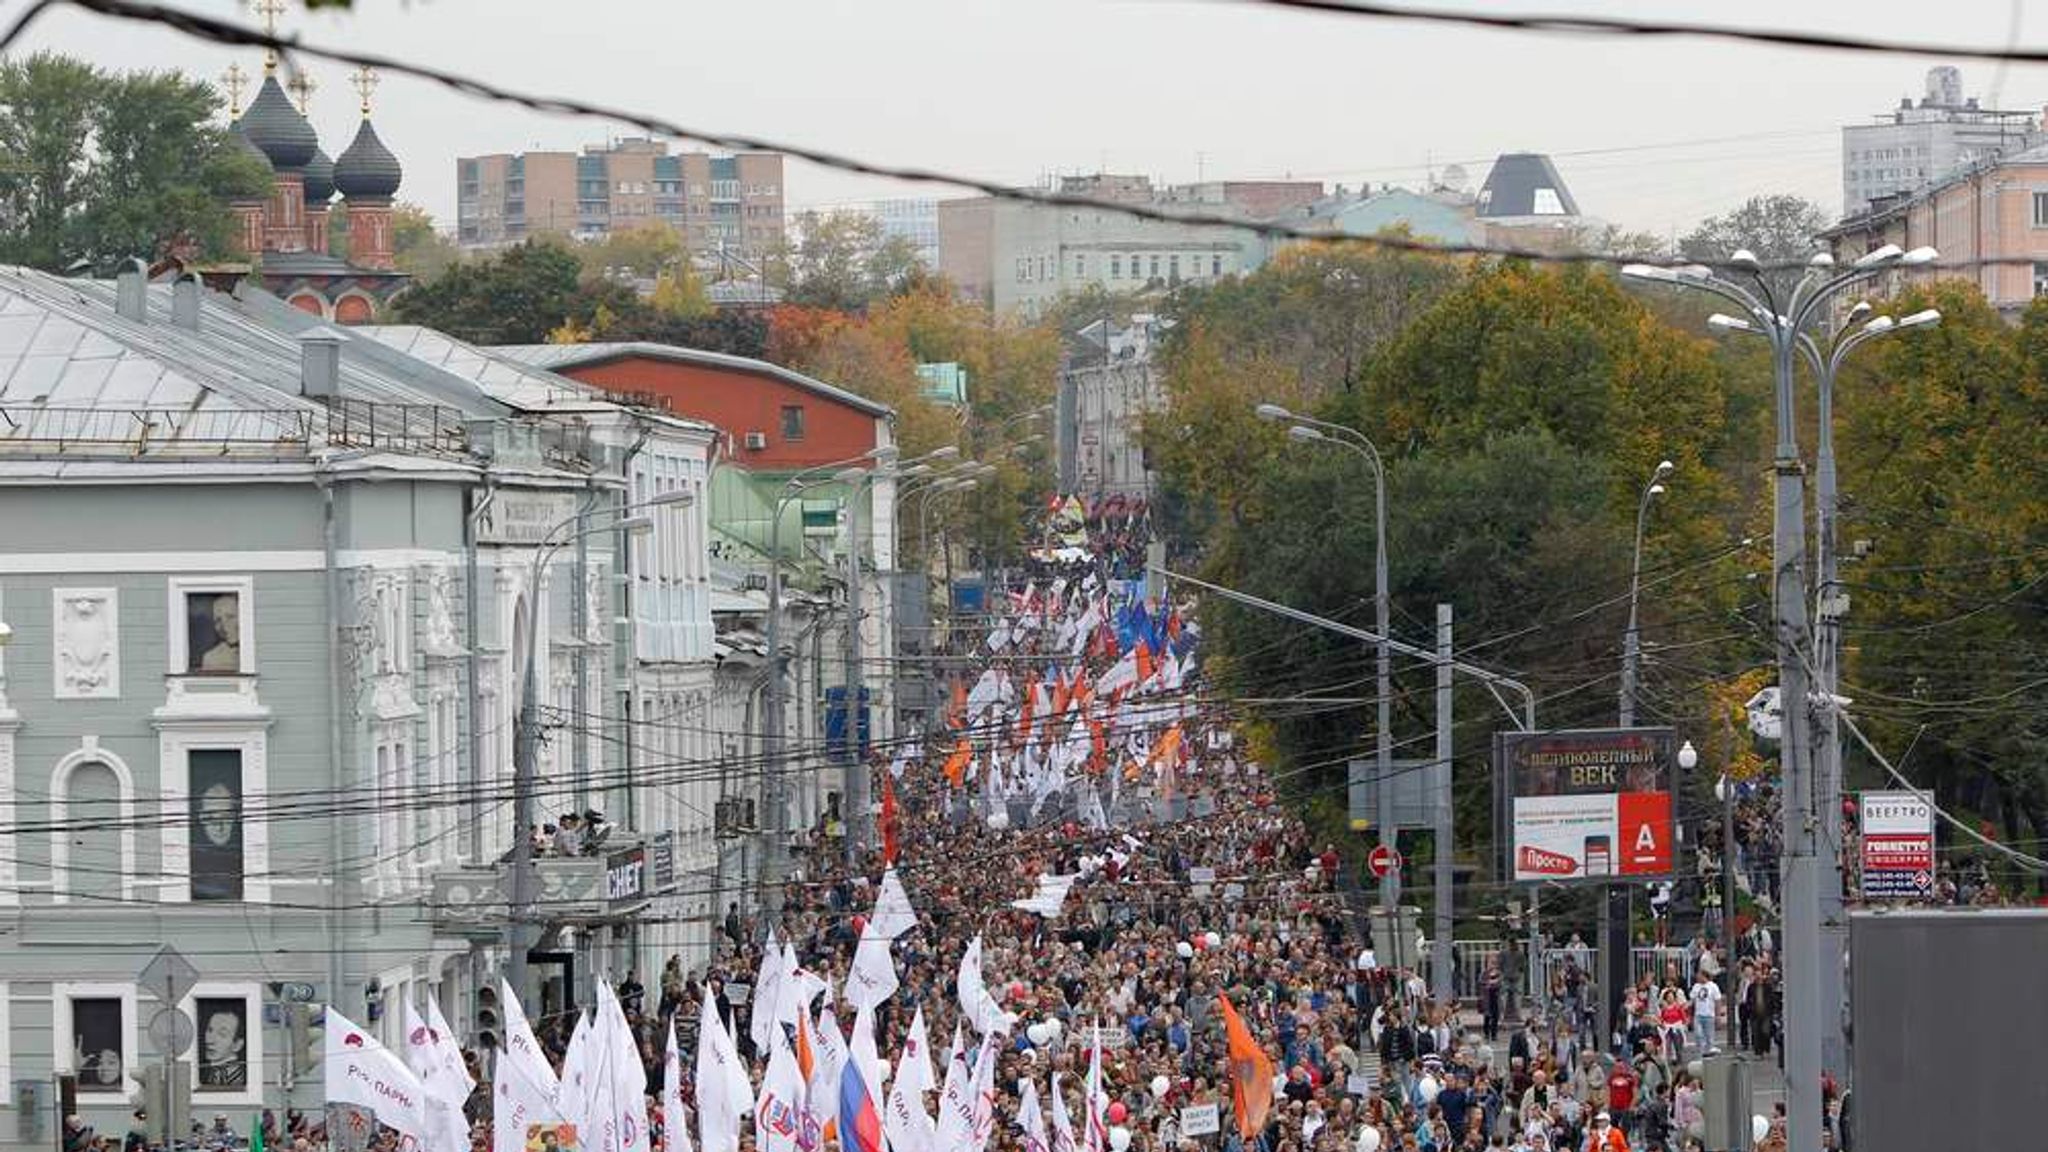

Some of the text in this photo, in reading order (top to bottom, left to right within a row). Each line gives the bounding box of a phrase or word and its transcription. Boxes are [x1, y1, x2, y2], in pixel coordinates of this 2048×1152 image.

[1571, 765, 1616, 786] ВЕК
[1866, 806, 1928, 818] BEEFTRO
[1527, 849, 1569, 870] Просто
